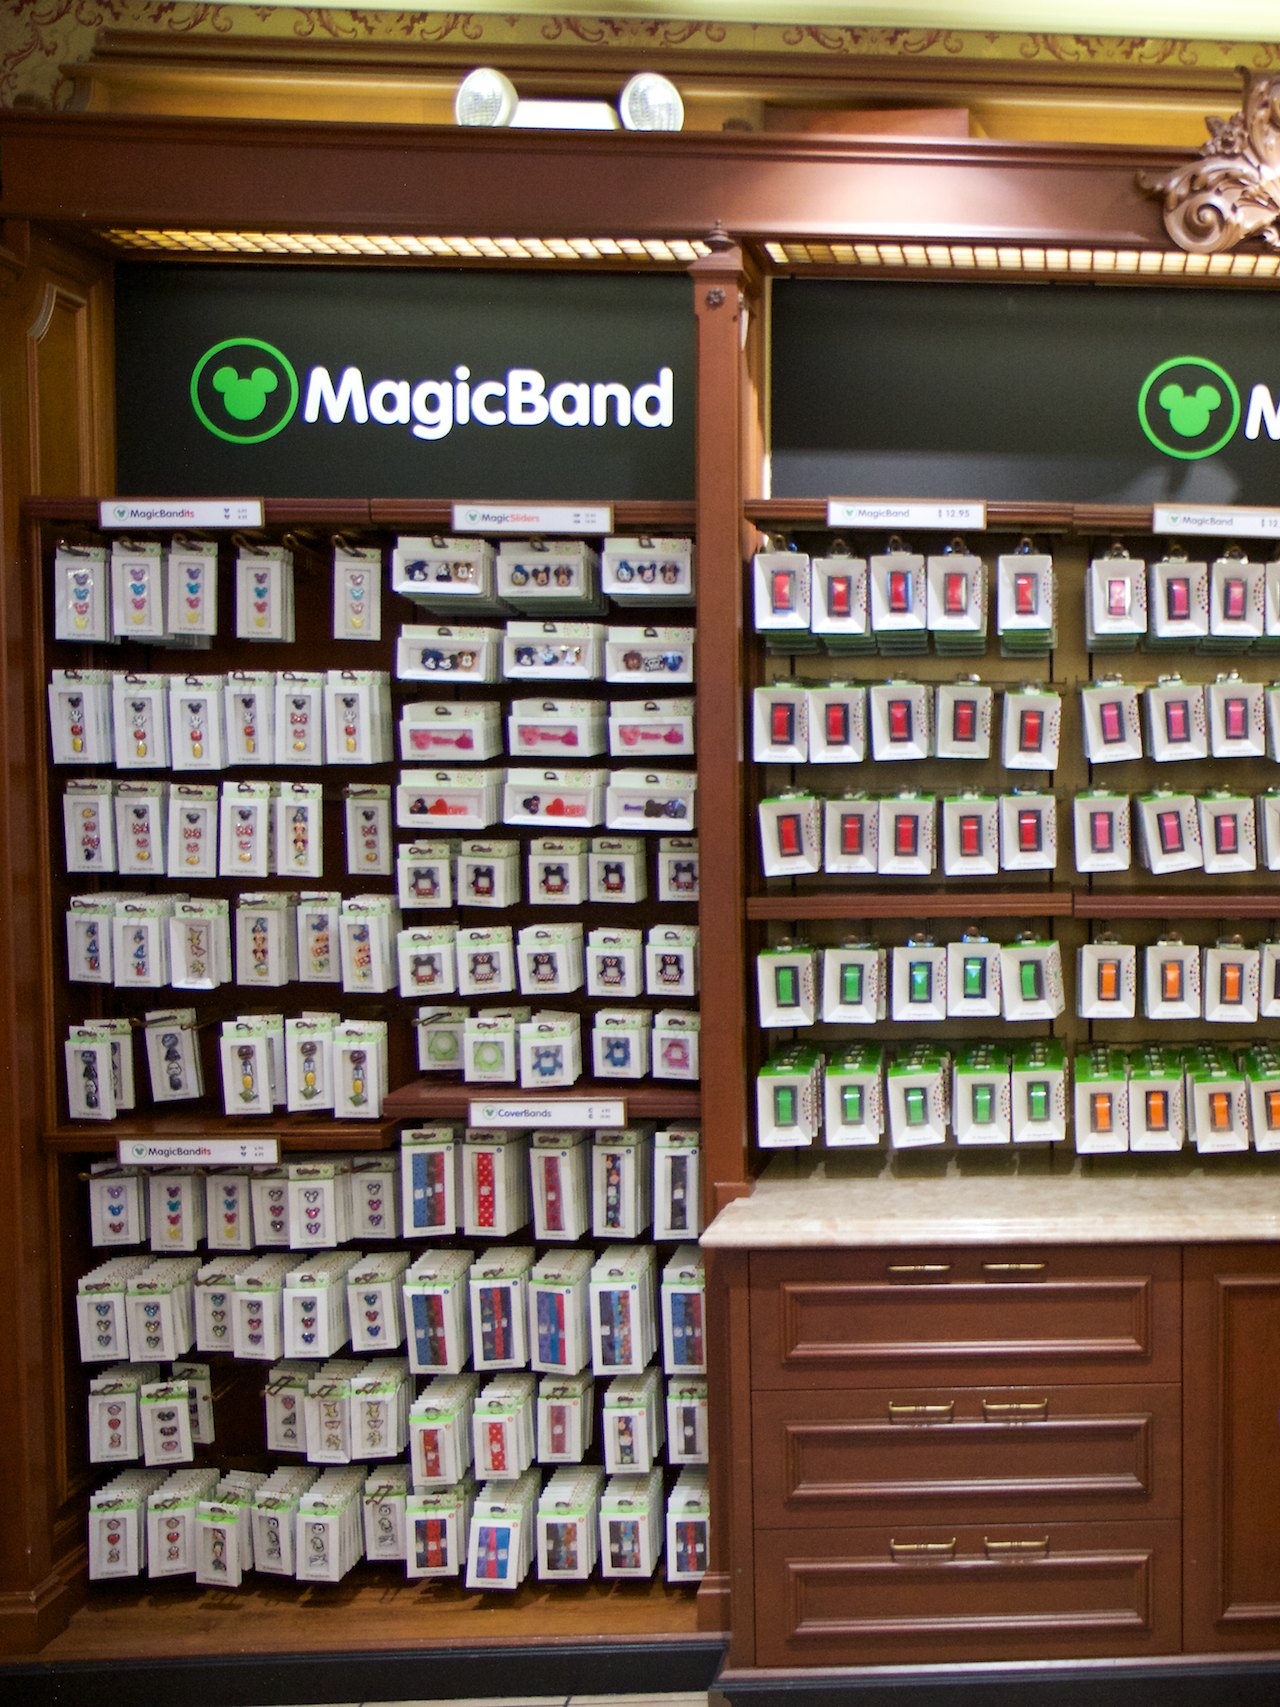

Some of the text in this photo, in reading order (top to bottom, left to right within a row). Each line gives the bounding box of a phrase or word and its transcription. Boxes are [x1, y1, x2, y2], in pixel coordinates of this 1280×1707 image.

[303, 364, 675, 440] MagicBand
[130, 508, 195, 520] MagicBandits
[481, 513, 540, 524] MagicSliders
[857, 508, 910, 519] MagicBand
[945, 509, 970, 518] 12.95
[1182, 515, 1234, 527] MagicBand
[497, 1108, 552, 1119] CoverBands
[148, 1146, 212, 1158] MagicBandits
